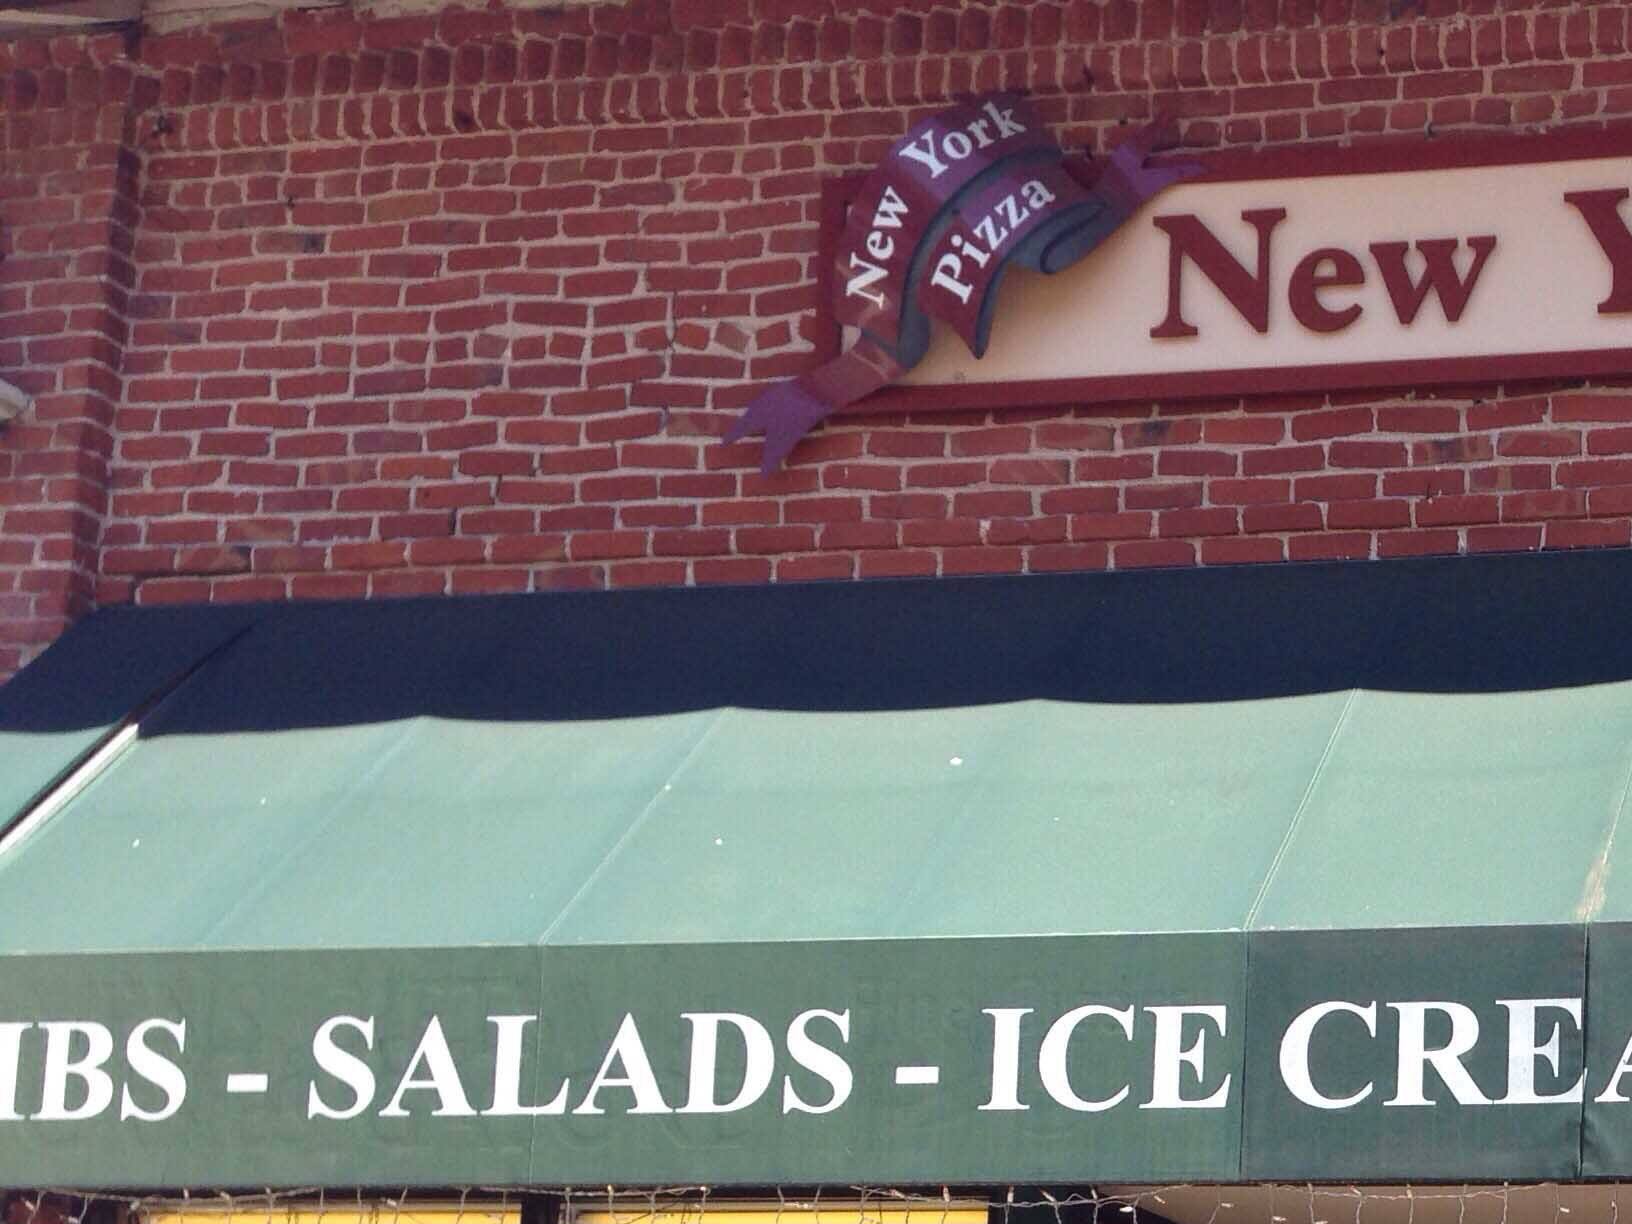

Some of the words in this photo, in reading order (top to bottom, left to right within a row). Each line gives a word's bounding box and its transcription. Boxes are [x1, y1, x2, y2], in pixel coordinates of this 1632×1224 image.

[844, 185, 910, 309] New
[898, 102, 1027, 179] York
[930, 175, 1056, 304] Pizza
[1149, 207, 1498, 339] New
[307, 1009, 854, 1120] SALADS
[977, 1004, 1231, 1111] ICE
